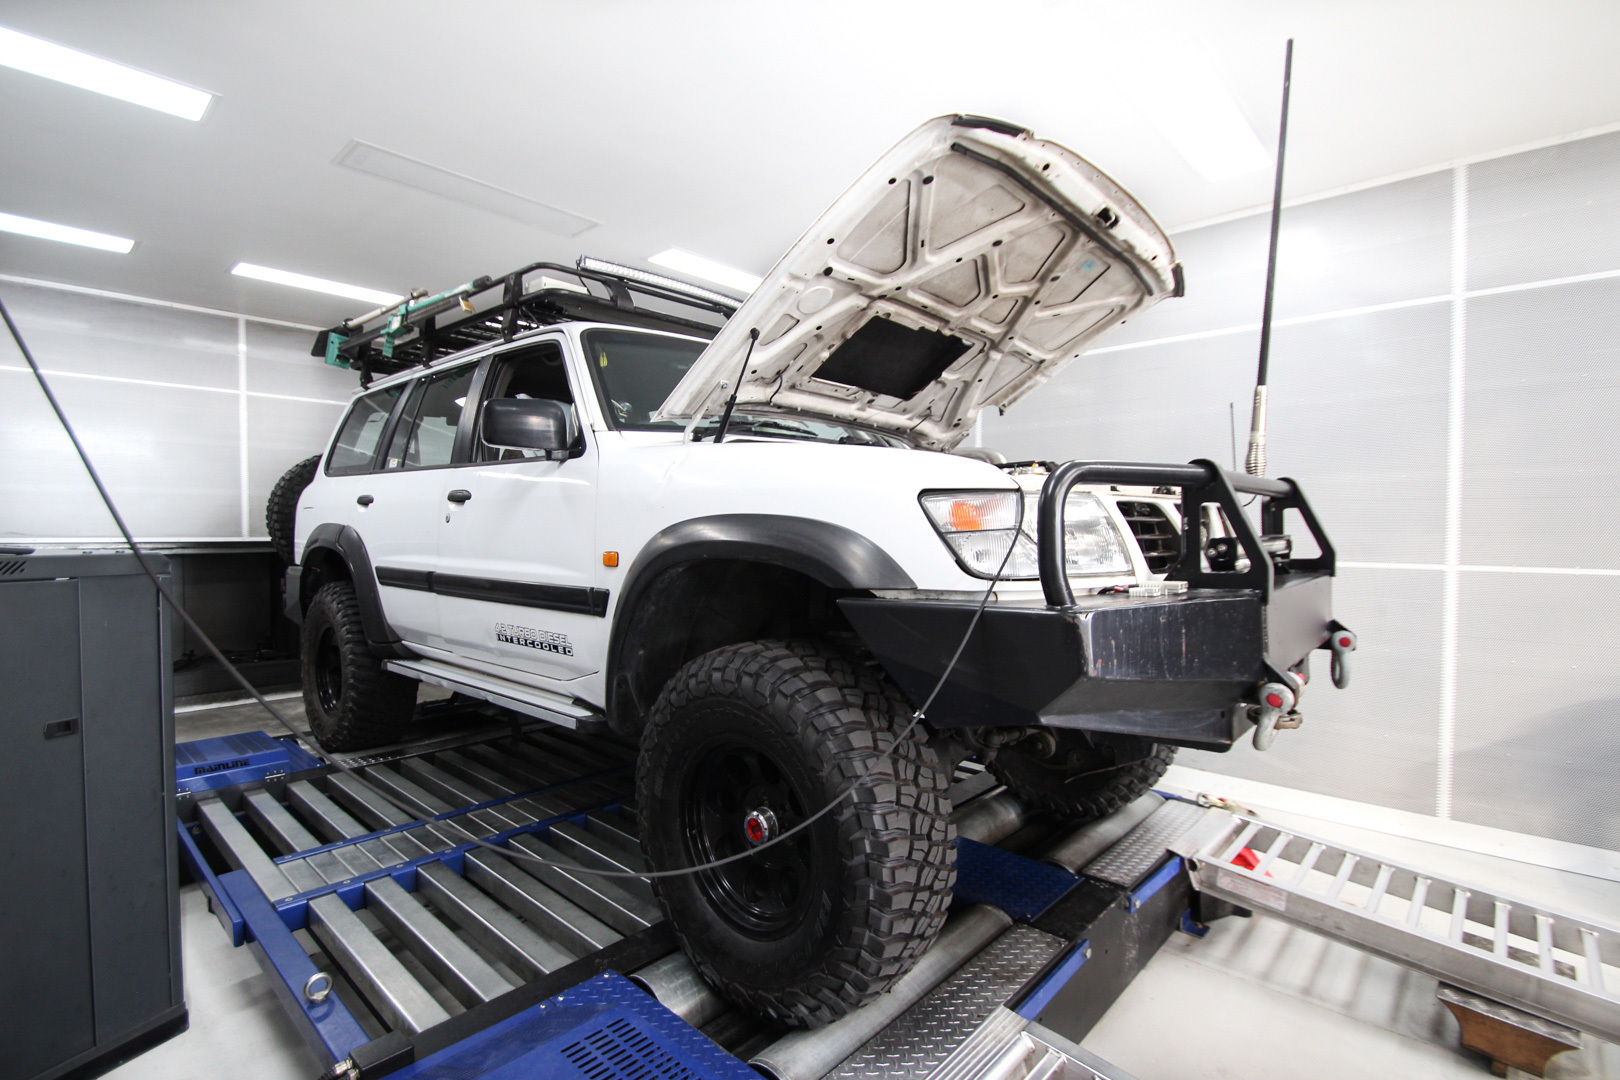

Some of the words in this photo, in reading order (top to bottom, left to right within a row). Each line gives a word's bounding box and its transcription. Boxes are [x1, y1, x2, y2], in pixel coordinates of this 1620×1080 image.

[497, 634, 573, 656] INTERCOOLED
[507, 625, 537, 640] TURBO
[538, 630, 572, 647] DIESEL
